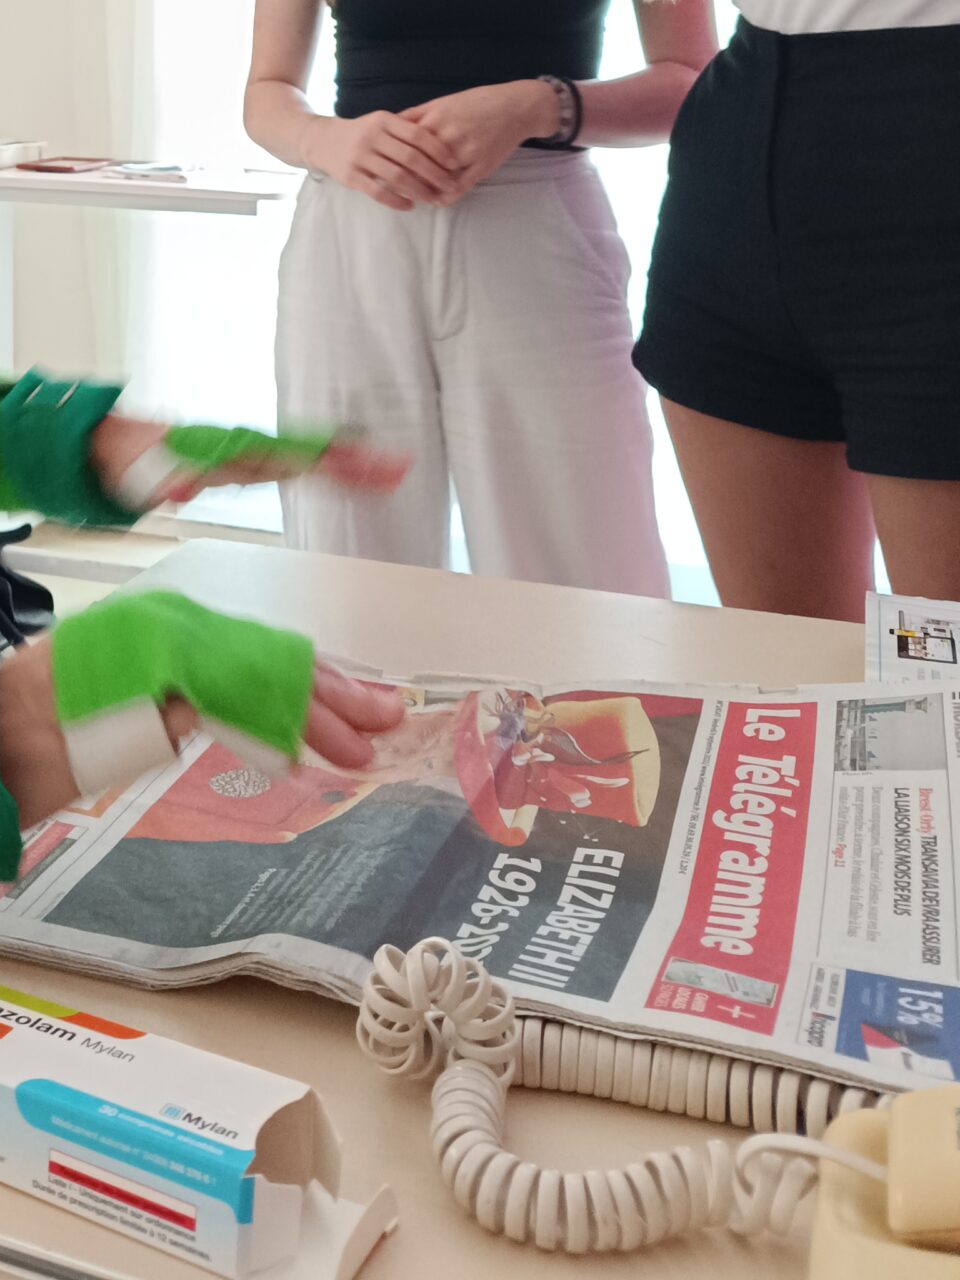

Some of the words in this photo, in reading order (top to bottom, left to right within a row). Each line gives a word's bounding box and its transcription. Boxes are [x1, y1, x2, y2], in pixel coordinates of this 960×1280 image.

[742, 708, 801, 742] Le
[894, 788, 911, 799] LA
[894, 800, 911, 838] LIAISON
[700, 754, 801, 956] Télégramme
[832, 843, 847, 859] Page
[894, 838, 911, 854] SIX
[894, 854, 912, 880] MOIS
[920, 835, 939, 889] TRANSAVIA
[893, 880, 912, 893] DE
[448, 853, 542, 962] 1926-20
[519, 847, 625, 972] ELIZABETH
[893, 893, 912, 916] PLUS
[922, 891, 941, 922] DEVRA
[921, 923, 942, 966] ASSURER
[508, 963, 571, 988] II
[896, 987, 944, 1028] 15%
[80, 1037, 136, 1063] Mylan
[182, 1112, 240, 1140] Mylan
